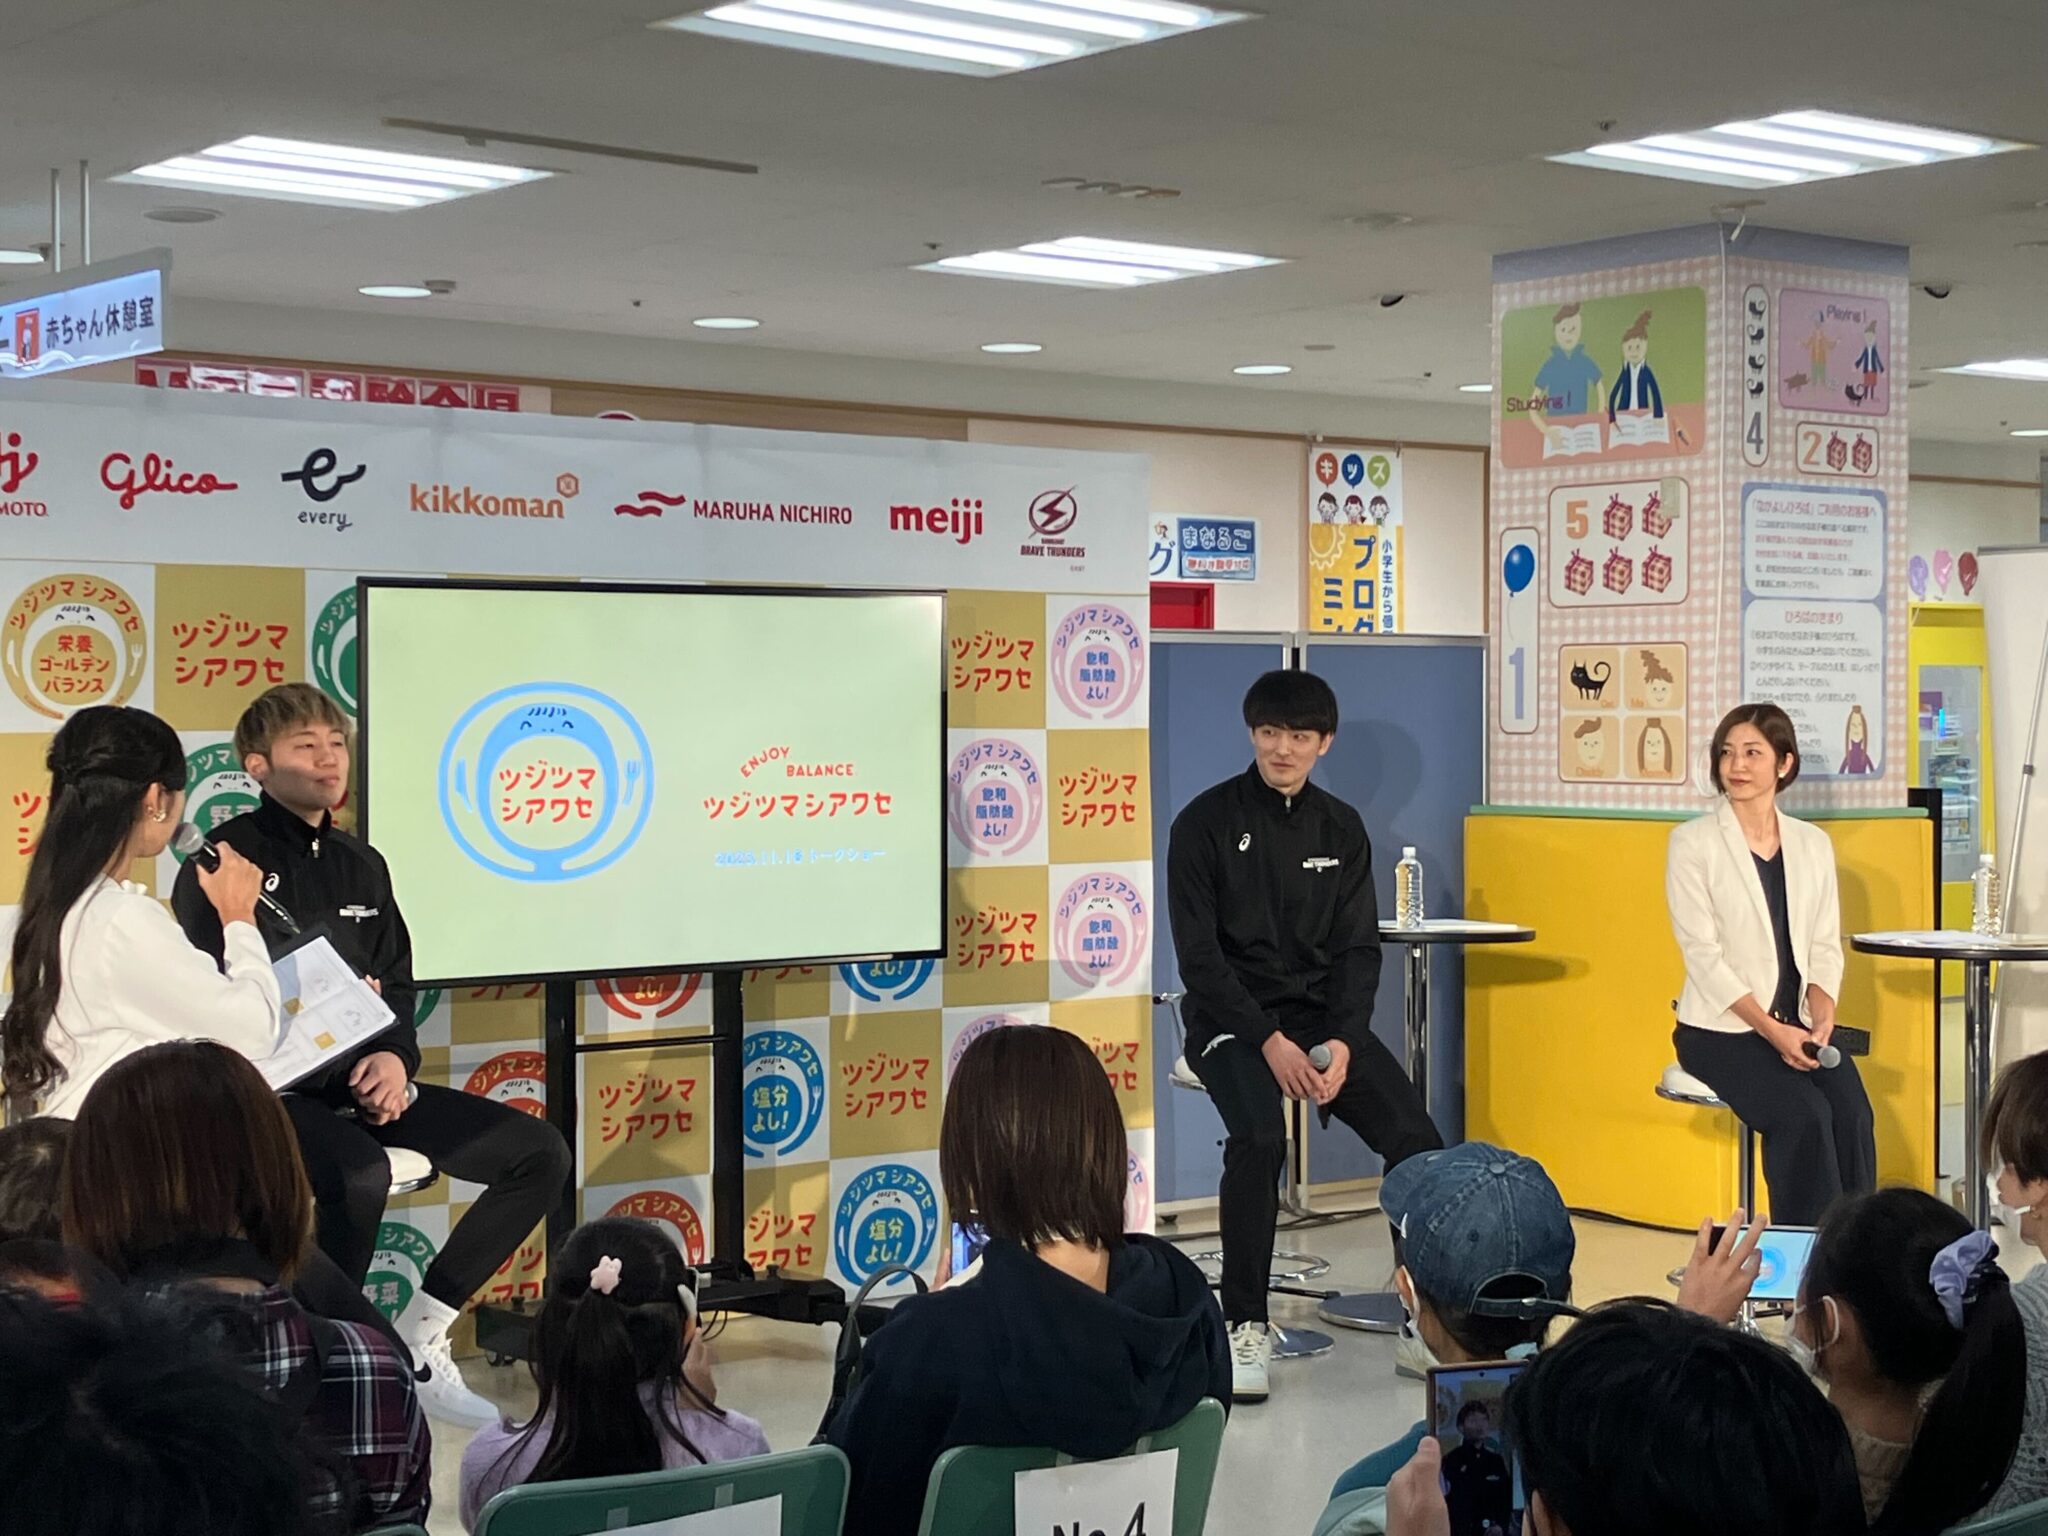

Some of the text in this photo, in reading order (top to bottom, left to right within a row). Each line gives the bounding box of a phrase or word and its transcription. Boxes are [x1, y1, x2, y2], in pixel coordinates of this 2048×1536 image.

[46, 297, 154, 348] 赤ちゃん休憩室
[1746, 412, 1764, 454] 4
[1802, 431, 1821, 464] 2
[100, 453, 238, 510] Glico
[410, 484, 565, 519] kikkoman
[694, 500, 852, 525] MARUHA NICHIRO
[298, 510, 353, 531] every
[890, 498, 983, 544] meiji
[1566, 501, 1588, 539] 5
[1021, 545, 1085, 557] BRAVE THUNDERS
[58, 635, 93, 653] 栄養
[172, 613, 289, 650] ツジツマ
[952, 630, 1034, 661] ツジツマ
[39, 656, 110, 673] ゴールデン
[175, 657, 285, 688] シアワセ
[954, 666, 1032, 692] シアワセ
[44, 676, 104, 693] バランス
[1509, 647, 1525, 720] 1
[498, 760, 596, 791] ツジツマ
[740, 746, 854, 778] ENJOY BALANCE
[1059, 767, 1137, 796] ツジツマ
[501, 797, 593, 824] シアワセ
[704, 791, 891, 819] ツジツマシアワセ
[1061, 802, 1136, 828] シアワセ
[955, 905, 1037, 936] ツジツマ
[957, 941, 1035, 969] シアワセ
[842, 1051, 930, 1086] ツジツマ
[599, 1073, 696, 1109] ツジツマ
[753, 1085, 789, 1107] 塩分
[845, 1087, 927, 1118] シアワセ
[601, 1109, 693, 1143] シアワセ
[869, 1217, 904, 1240] 塩分
